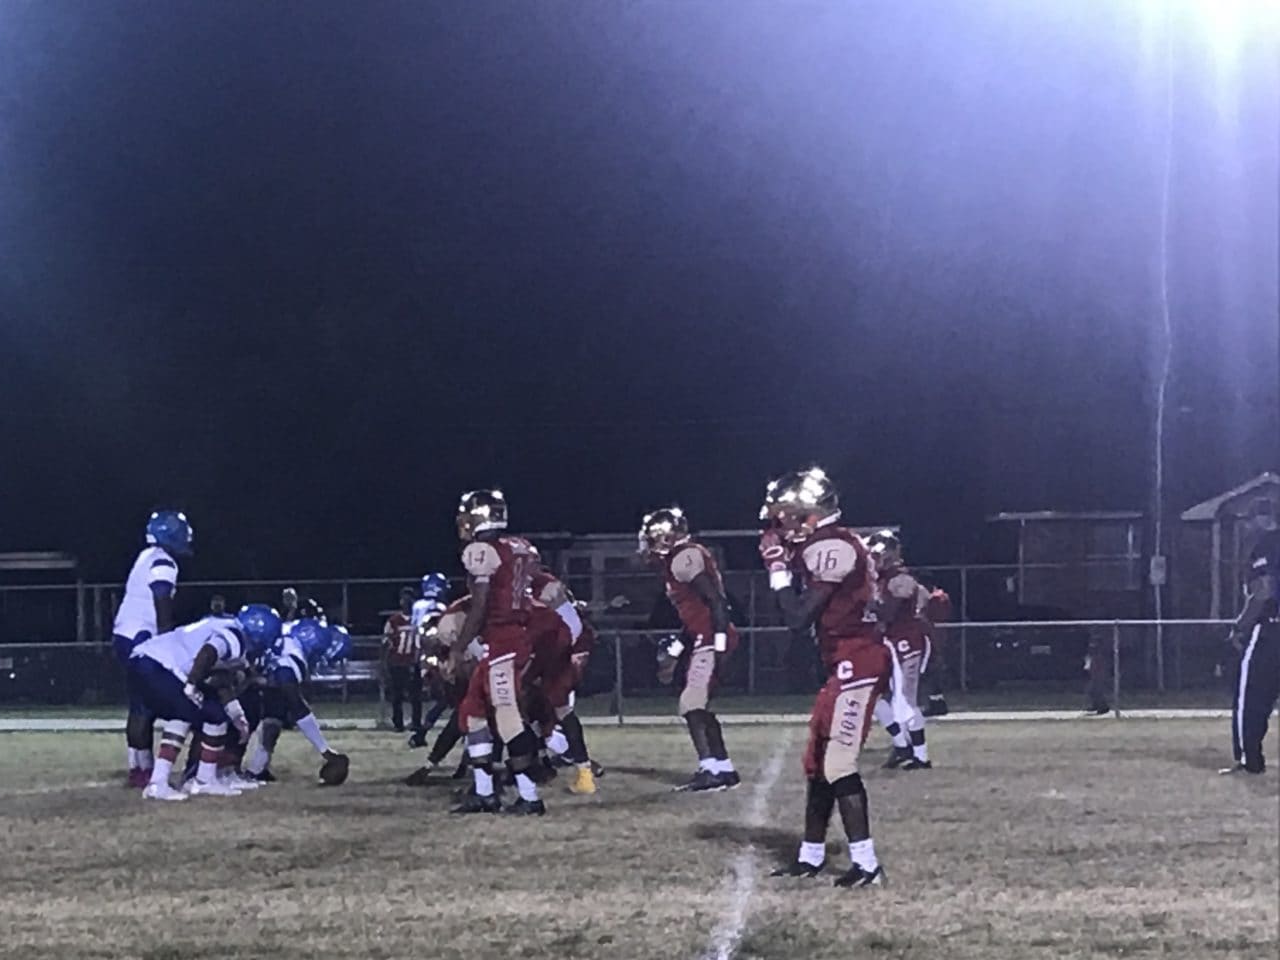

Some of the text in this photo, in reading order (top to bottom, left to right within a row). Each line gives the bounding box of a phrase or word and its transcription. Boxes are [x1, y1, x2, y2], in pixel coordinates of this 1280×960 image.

[816, 549, 841, 571] 16
[897, 639, 911, 652] C
[837, 660, 854, 680] C
[837, 698, 860, 747] LIONS
